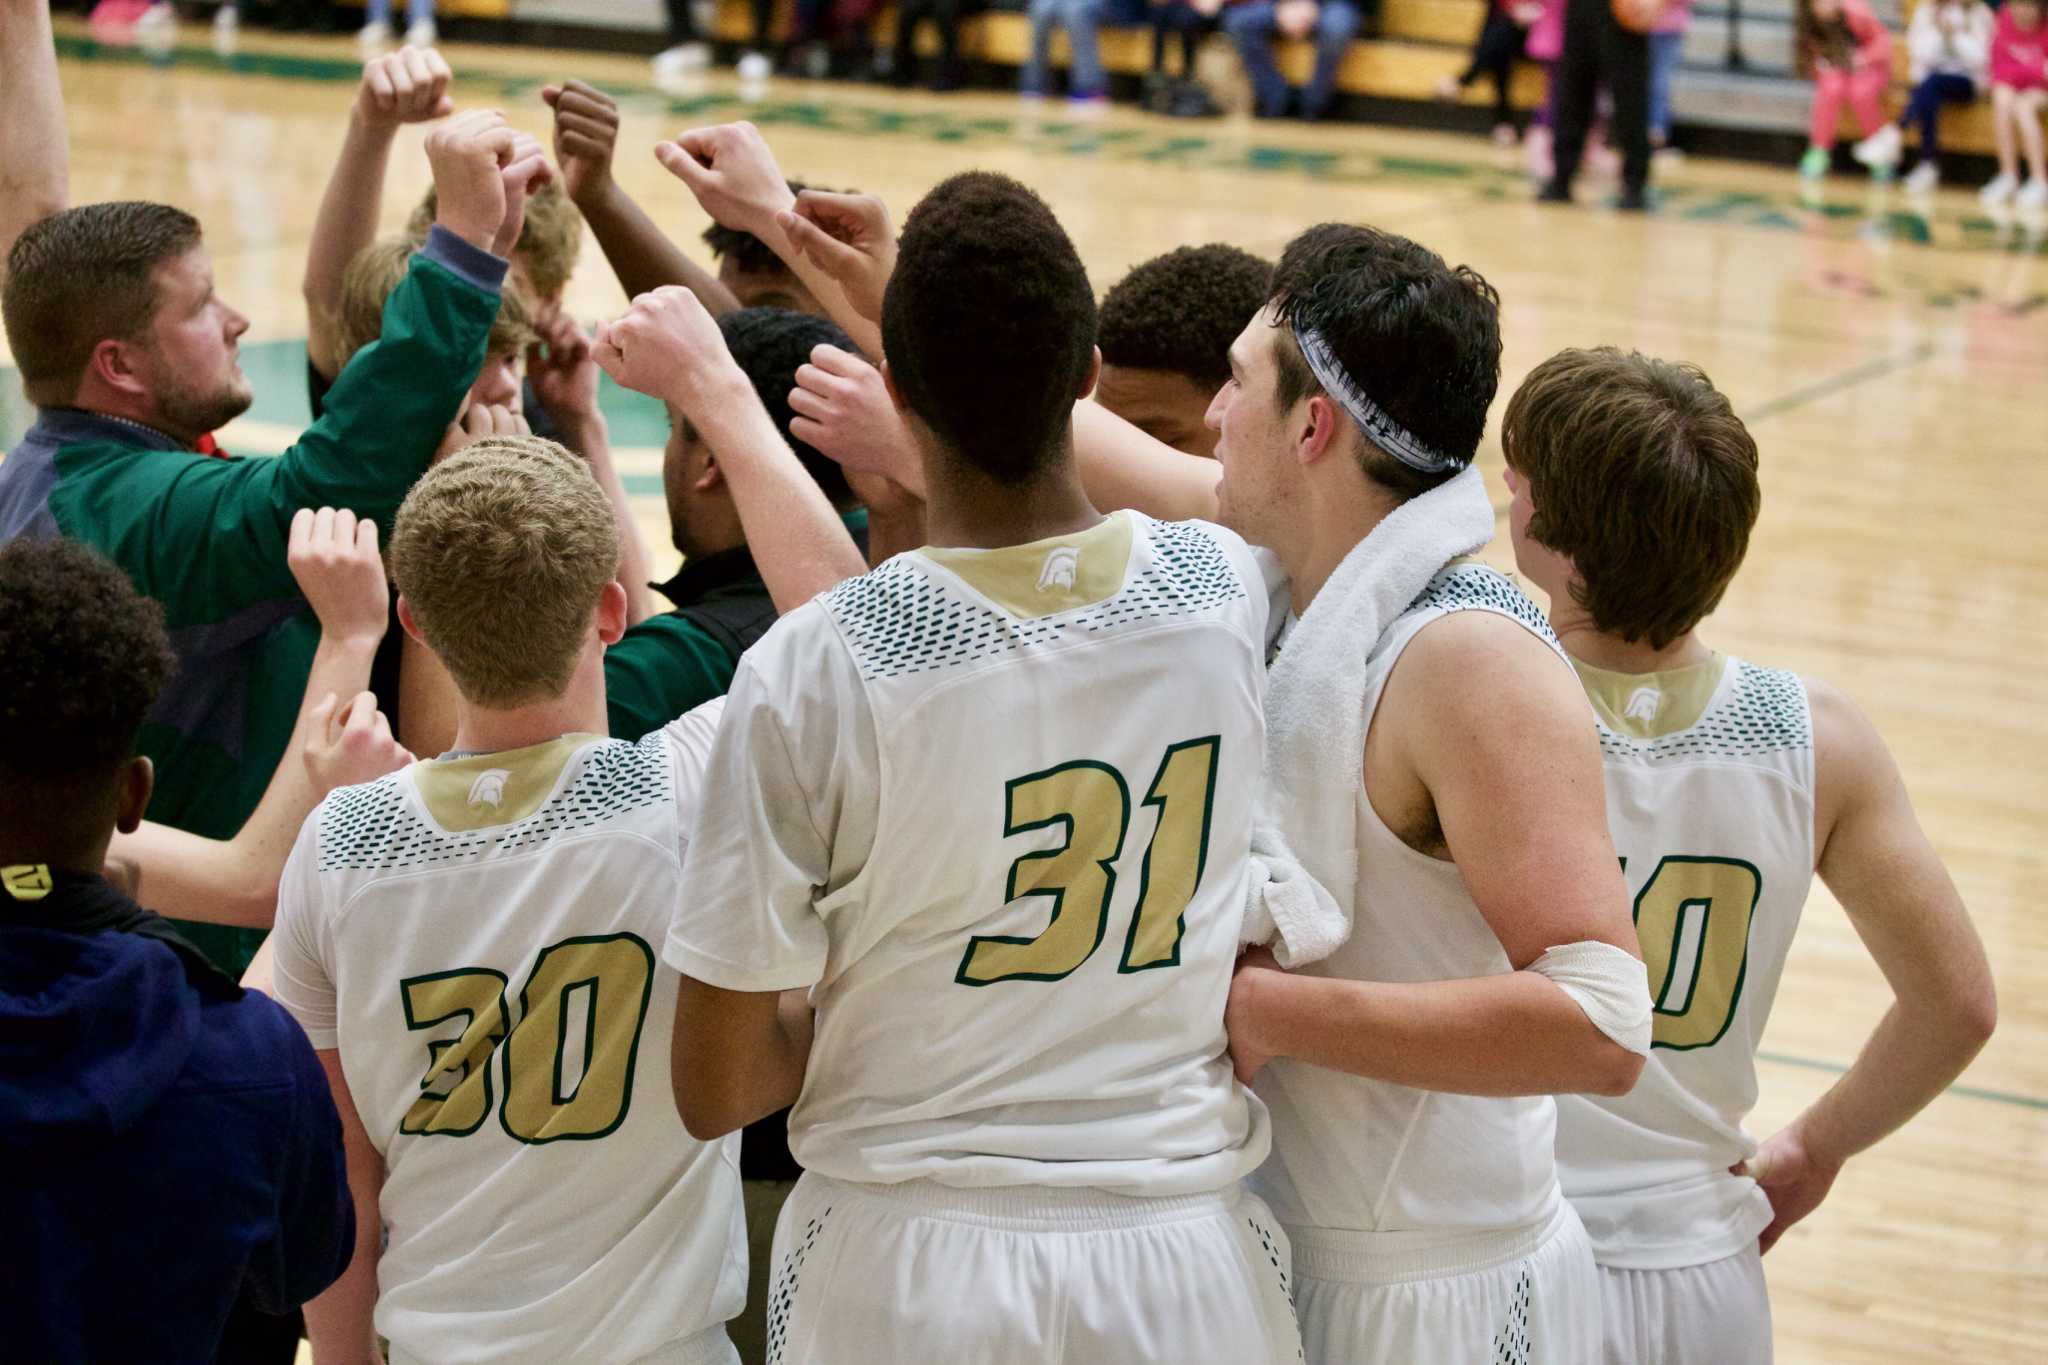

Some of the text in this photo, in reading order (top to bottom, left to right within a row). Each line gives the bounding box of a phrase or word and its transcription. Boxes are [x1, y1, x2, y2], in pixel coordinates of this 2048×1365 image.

[954, 734, 1221, 987] 31
[1618, 855, 1762, 1051] 0
[400, 931, 656, 1145] 30
